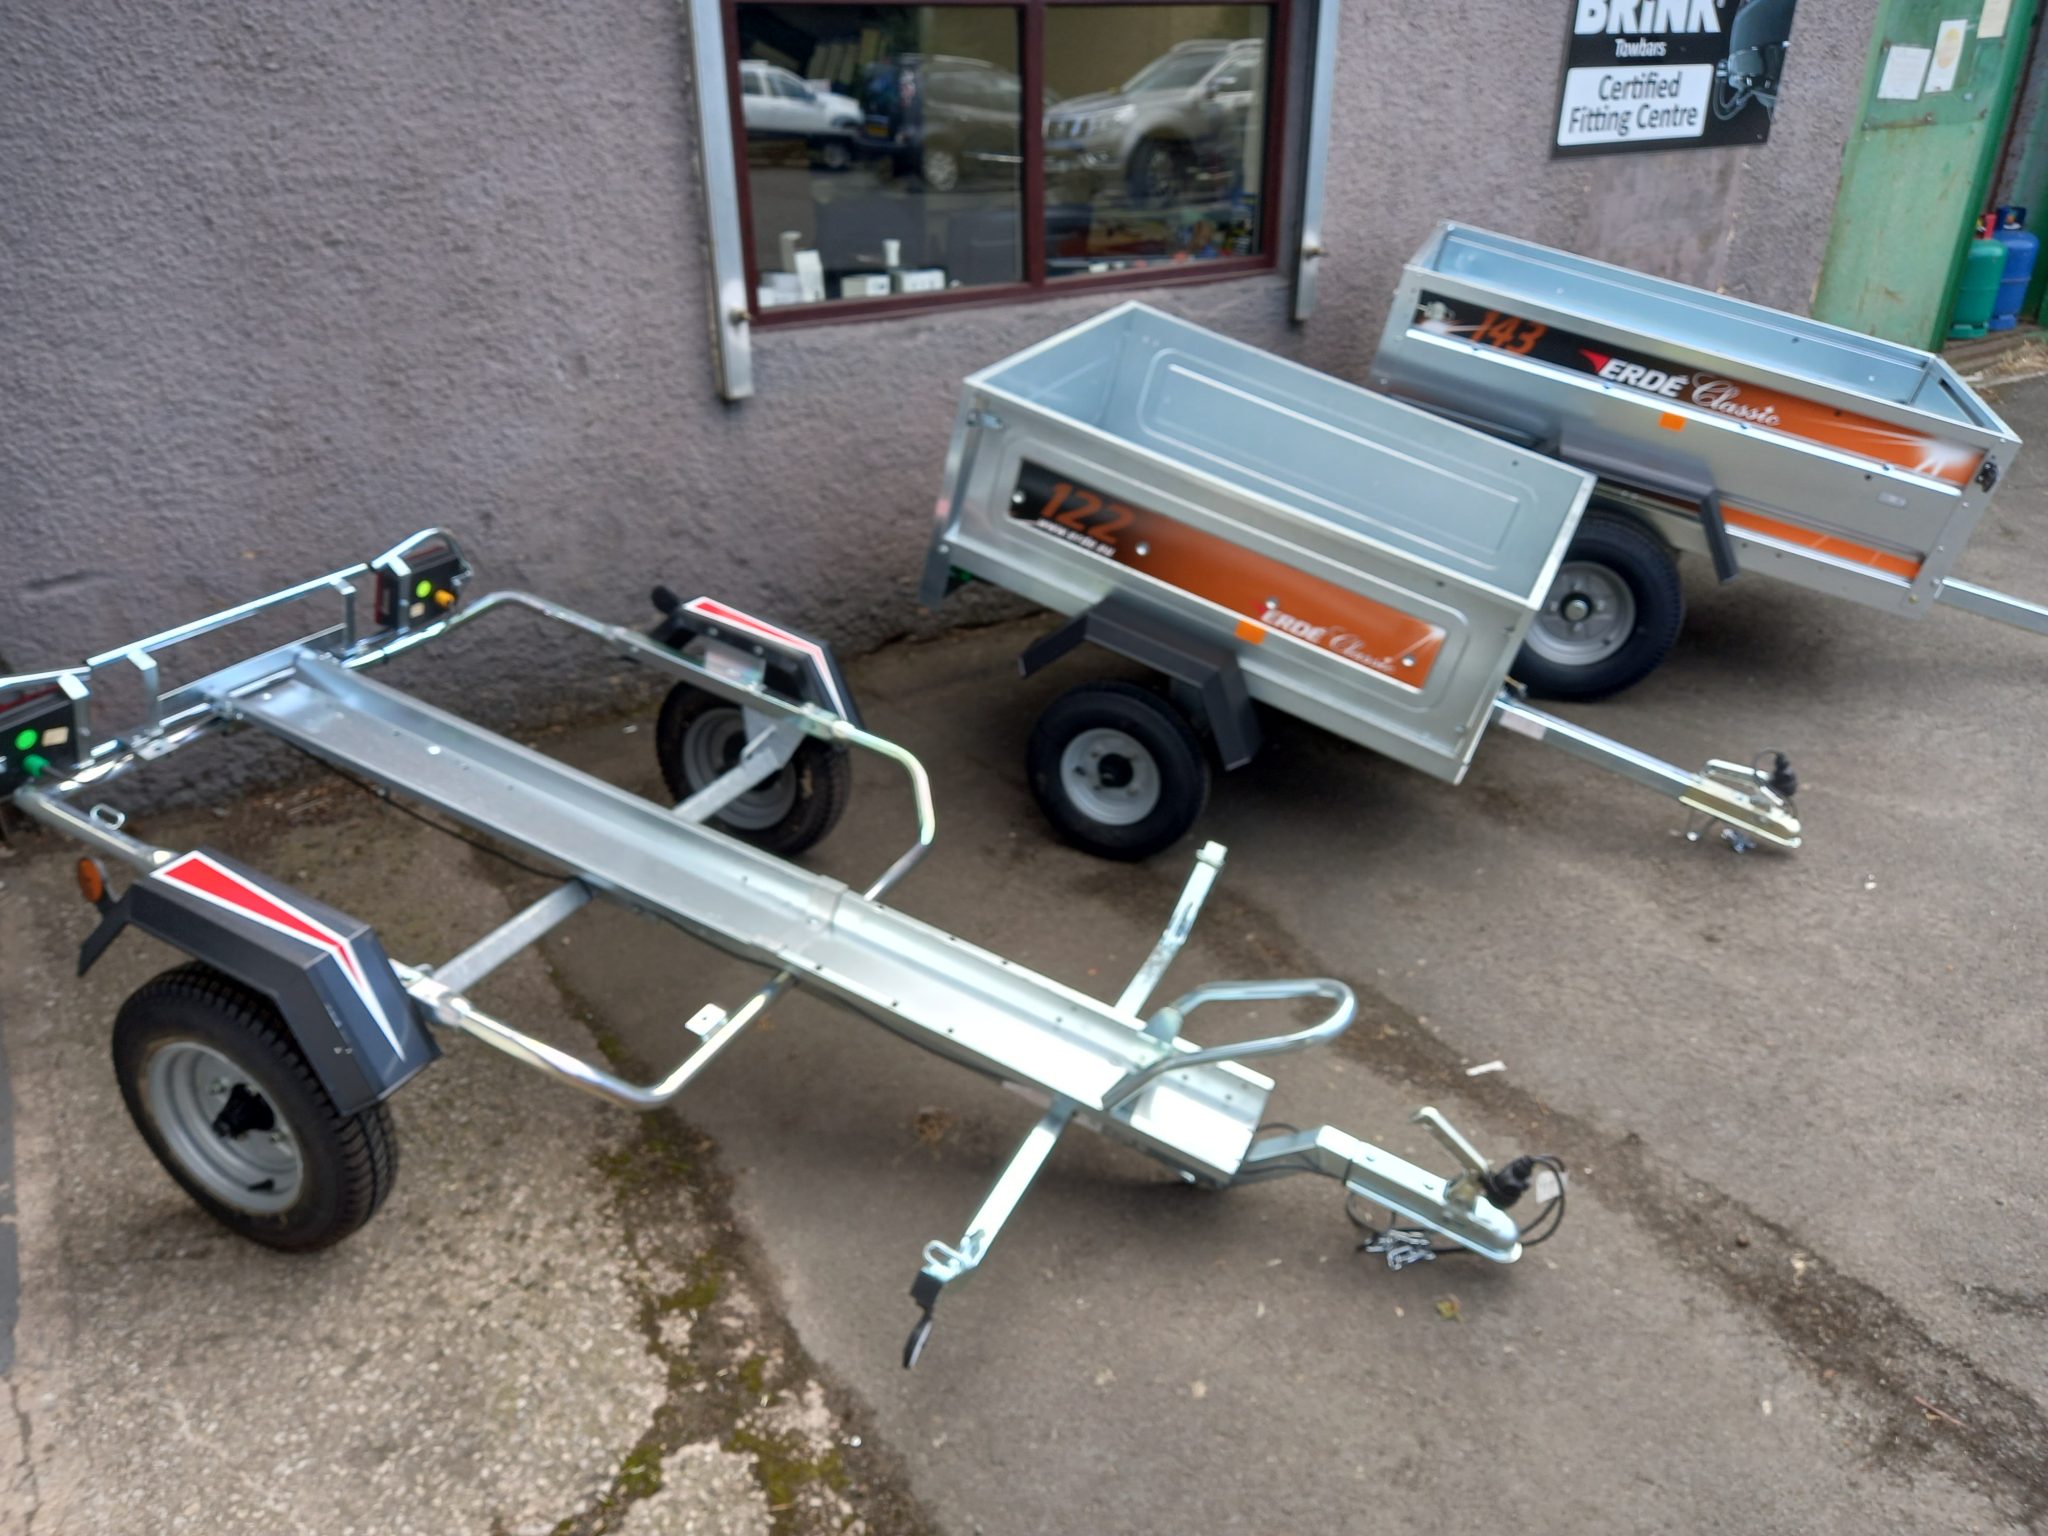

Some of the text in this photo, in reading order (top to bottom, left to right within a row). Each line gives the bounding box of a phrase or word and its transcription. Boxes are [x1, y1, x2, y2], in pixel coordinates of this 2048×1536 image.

[1615, 37, 1667, 57] Towbars
[1598, 71, 1682, 101] Certified
[1568, 104, 1699, 137] Fitting Centre
[1471, 310, 1548, 356] 143
[1691, 372, 1781, 427] Classic
[1041, 482, 1134, 545] 122
